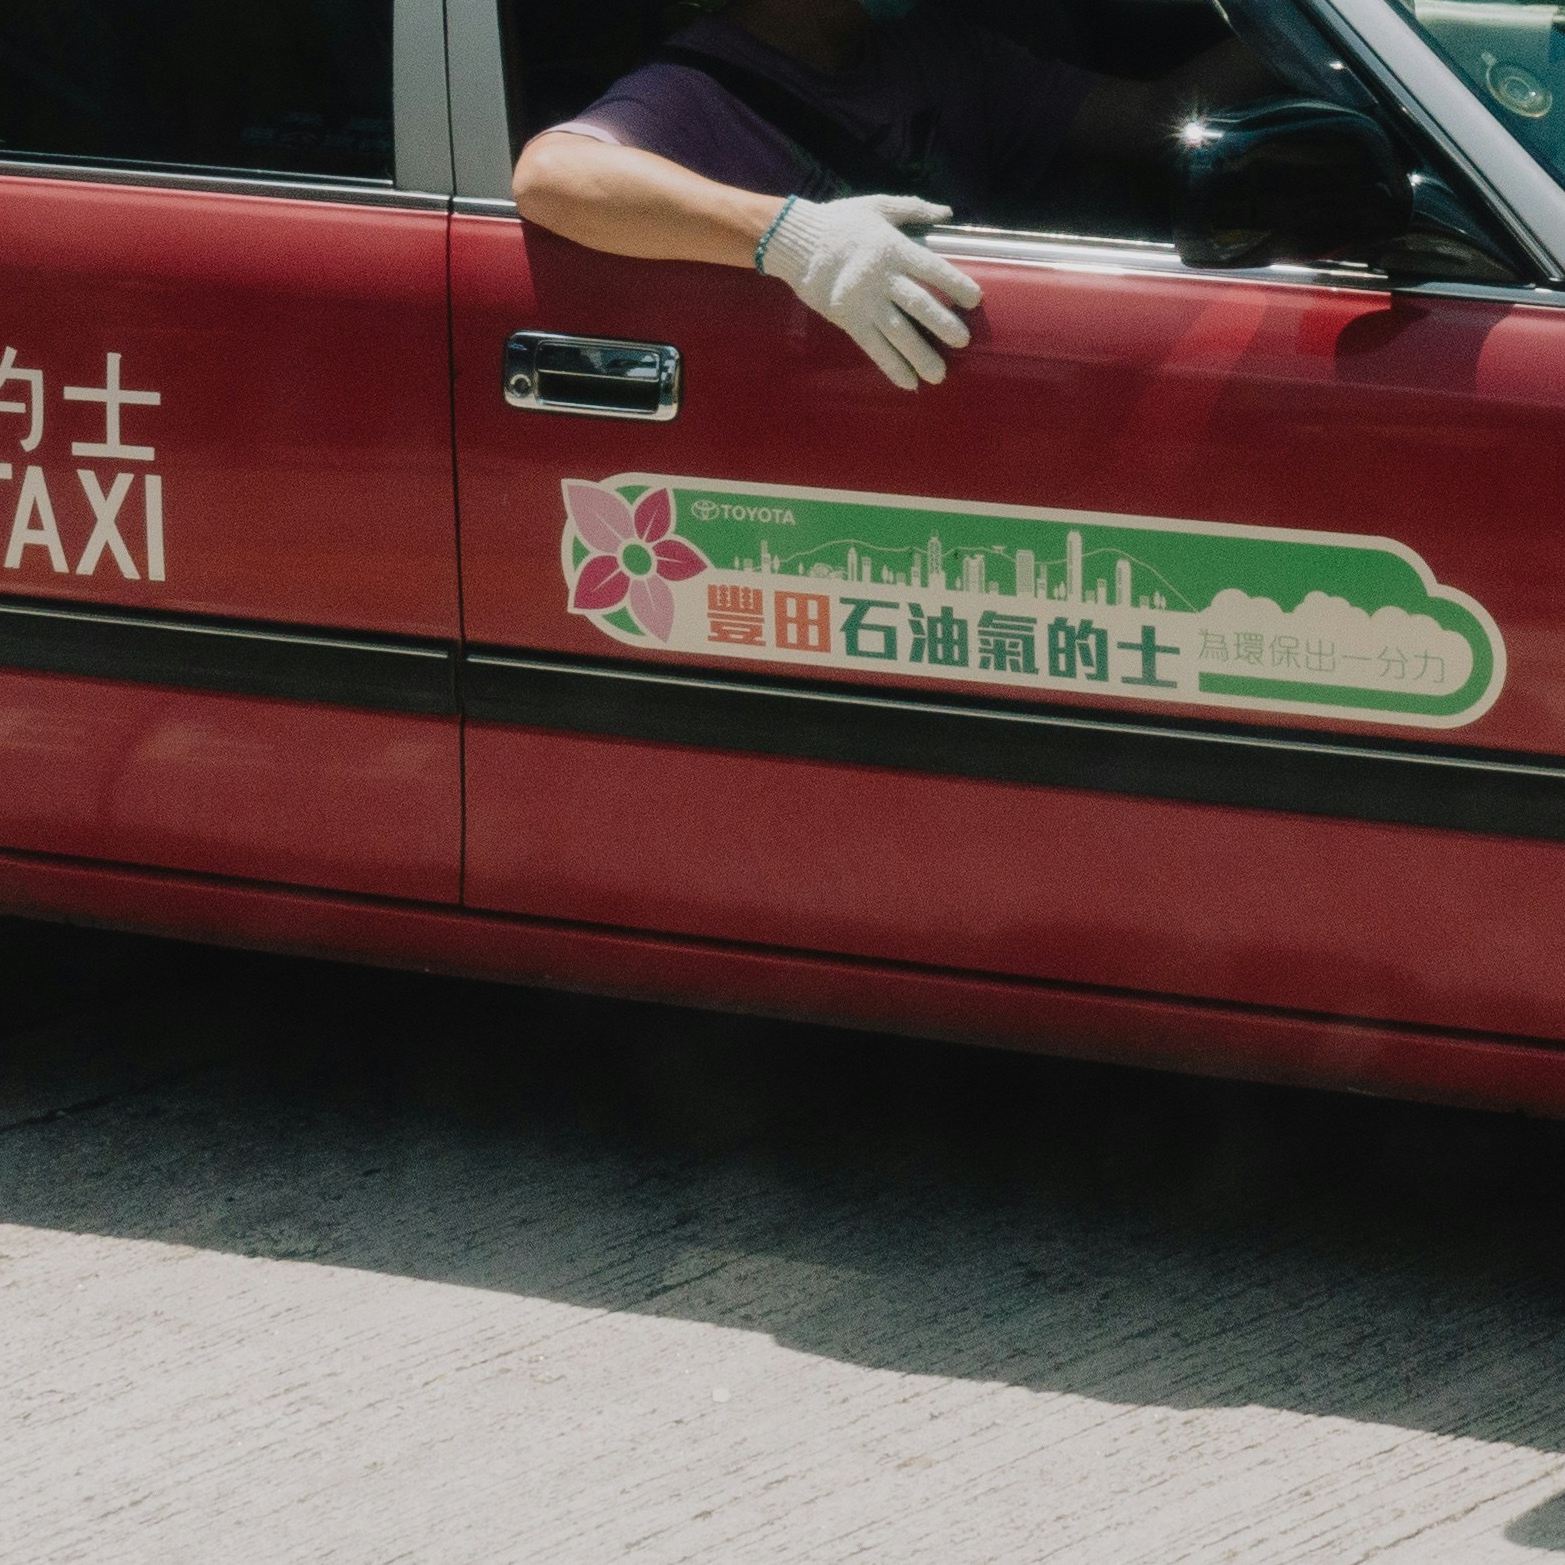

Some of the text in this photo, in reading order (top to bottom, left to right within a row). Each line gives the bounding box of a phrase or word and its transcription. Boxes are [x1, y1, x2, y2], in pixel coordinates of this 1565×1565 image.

[720, 504, 796, 527] TOYOTA
[706, 583, 1181, 689] 豐田石油氣的士
[1198, 627, 1445, 684] 為環保出一分力
